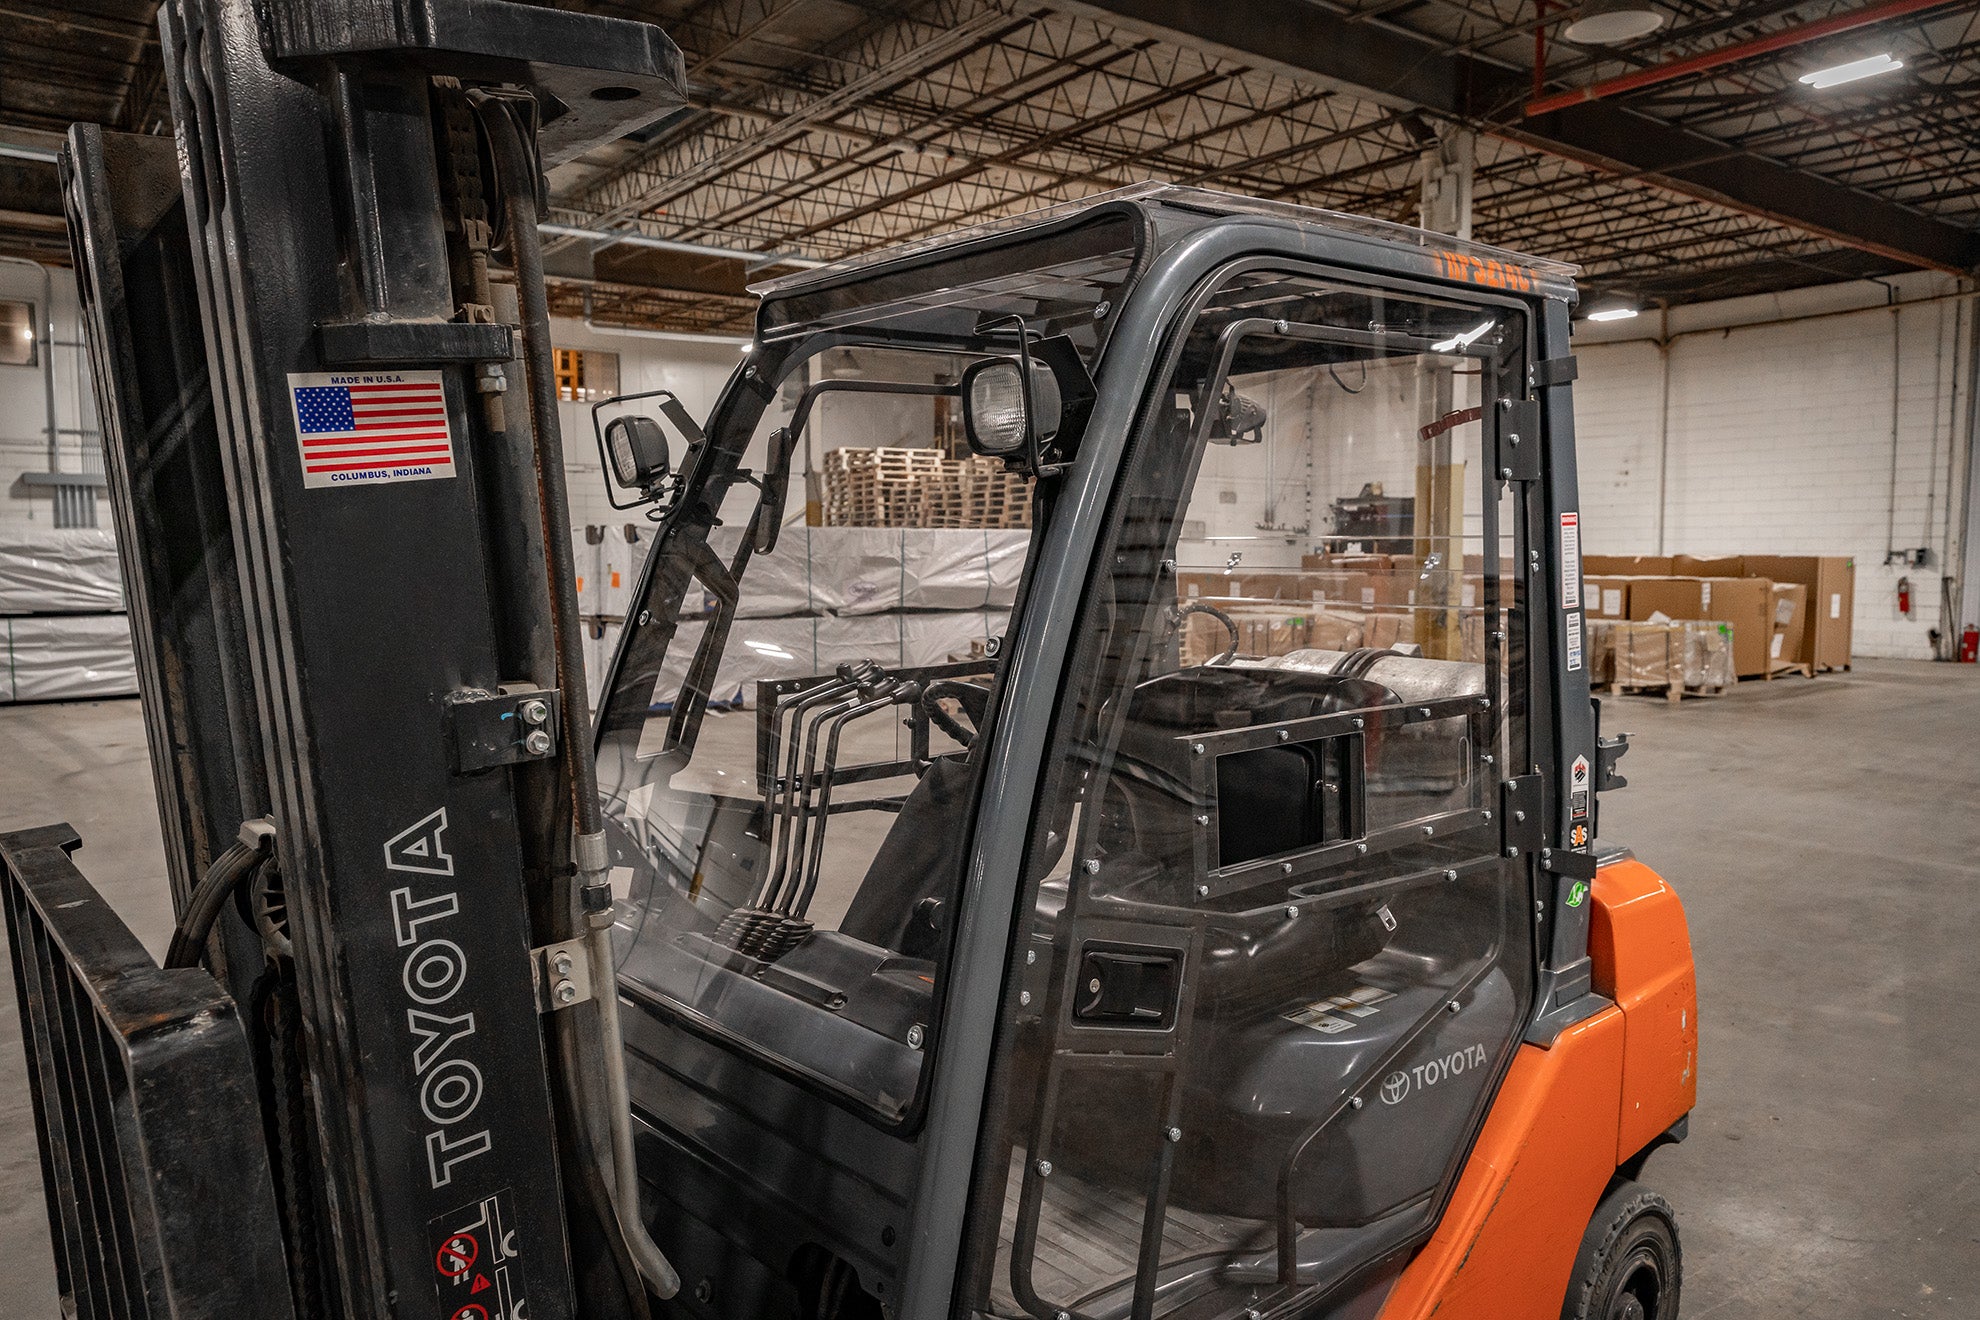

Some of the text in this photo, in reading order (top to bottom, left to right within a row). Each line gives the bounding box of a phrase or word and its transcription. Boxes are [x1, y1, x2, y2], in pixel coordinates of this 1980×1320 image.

[331, 375, 405, 384] MADE IN U.S.A.
[331, 467, 432, 481] COLUMBUS, INDIANA
[383, 806, 492, 1189] TOYOTA
[1412, 1043, 1487, 1090] TOYOTA
